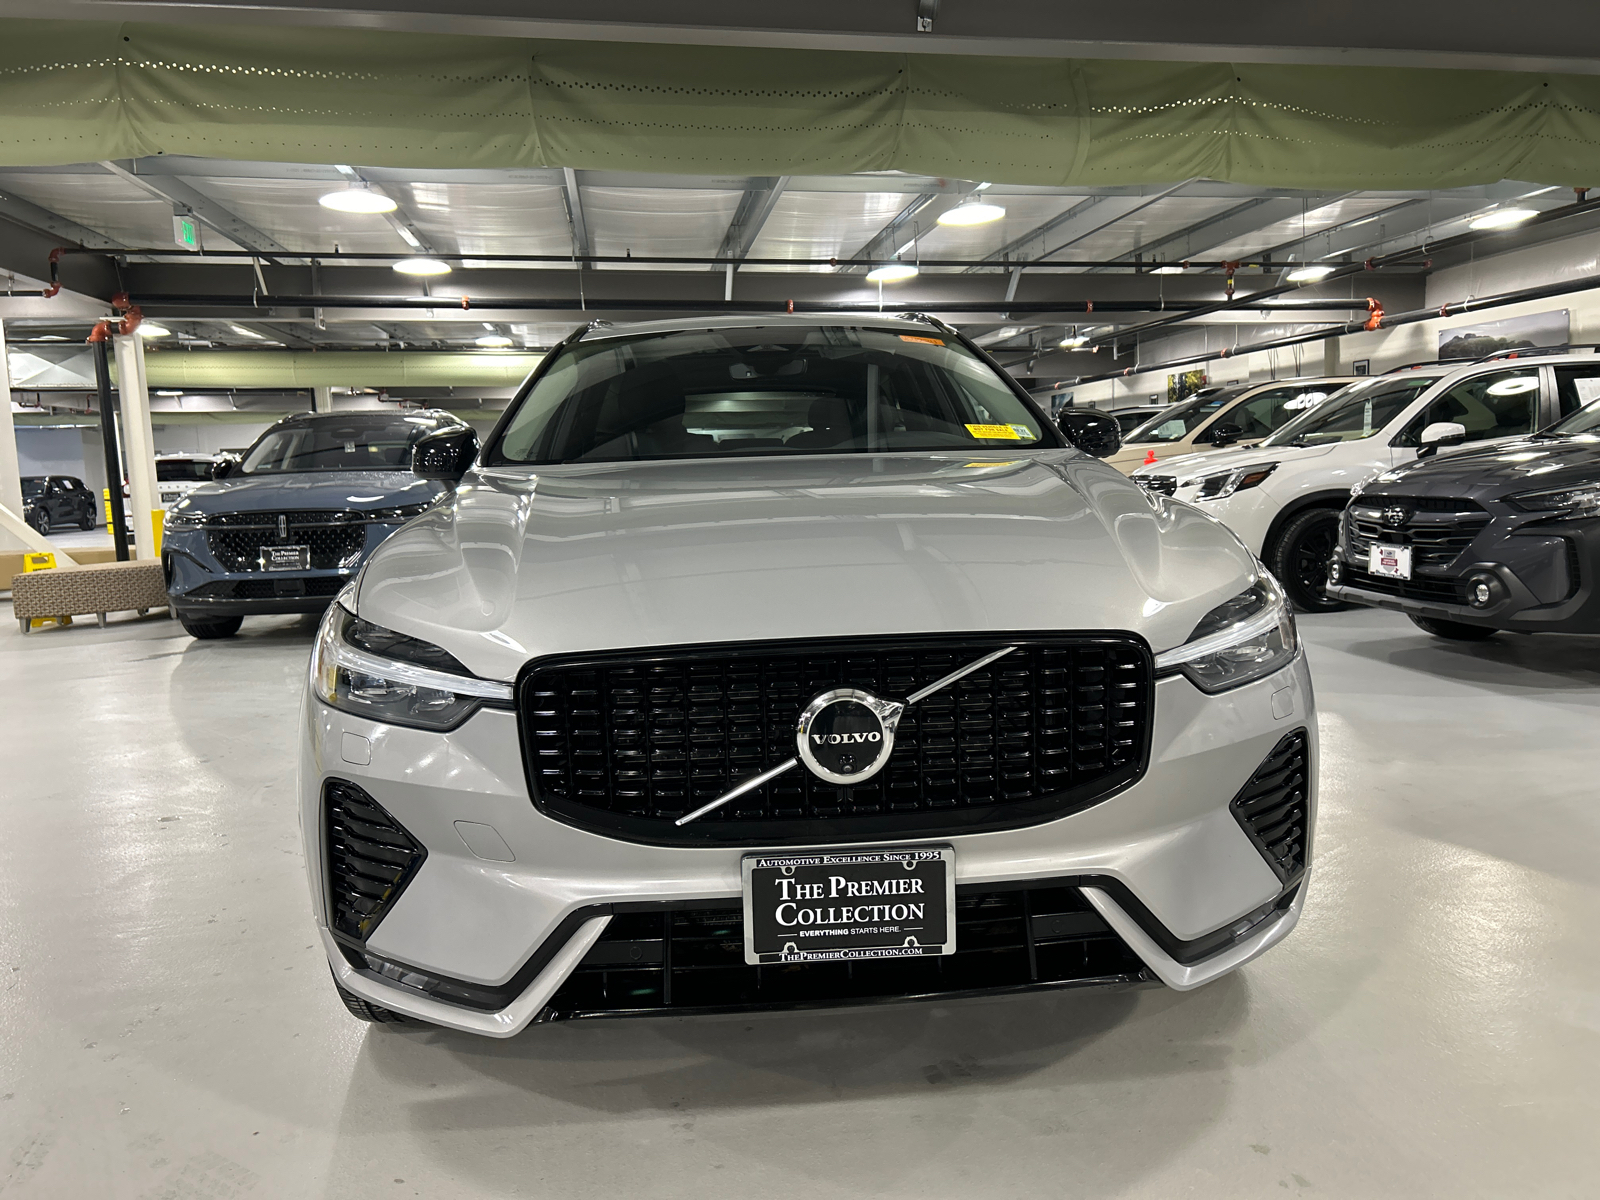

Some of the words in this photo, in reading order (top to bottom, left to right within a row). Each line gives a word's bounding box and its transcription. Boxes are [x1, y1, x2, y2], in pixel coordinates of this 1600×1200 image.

[811, 731, 881, 745] VOLVO
[758, 857, 821, 867] AUTOMOTIVE
[823, 855, 881, 864] EXCELLENCE
[883, 853, 911, 862] SINCE
[914, 851, 940, 860] 1995
[774, 877, 825, 900] THE
[828, 875, 925, 899] PREMIER
[774, 902, 925, 927] COLLECTION
[799, 929, 849, 937] EVERYTHING
[850, 927, 878, 935] STARTS
